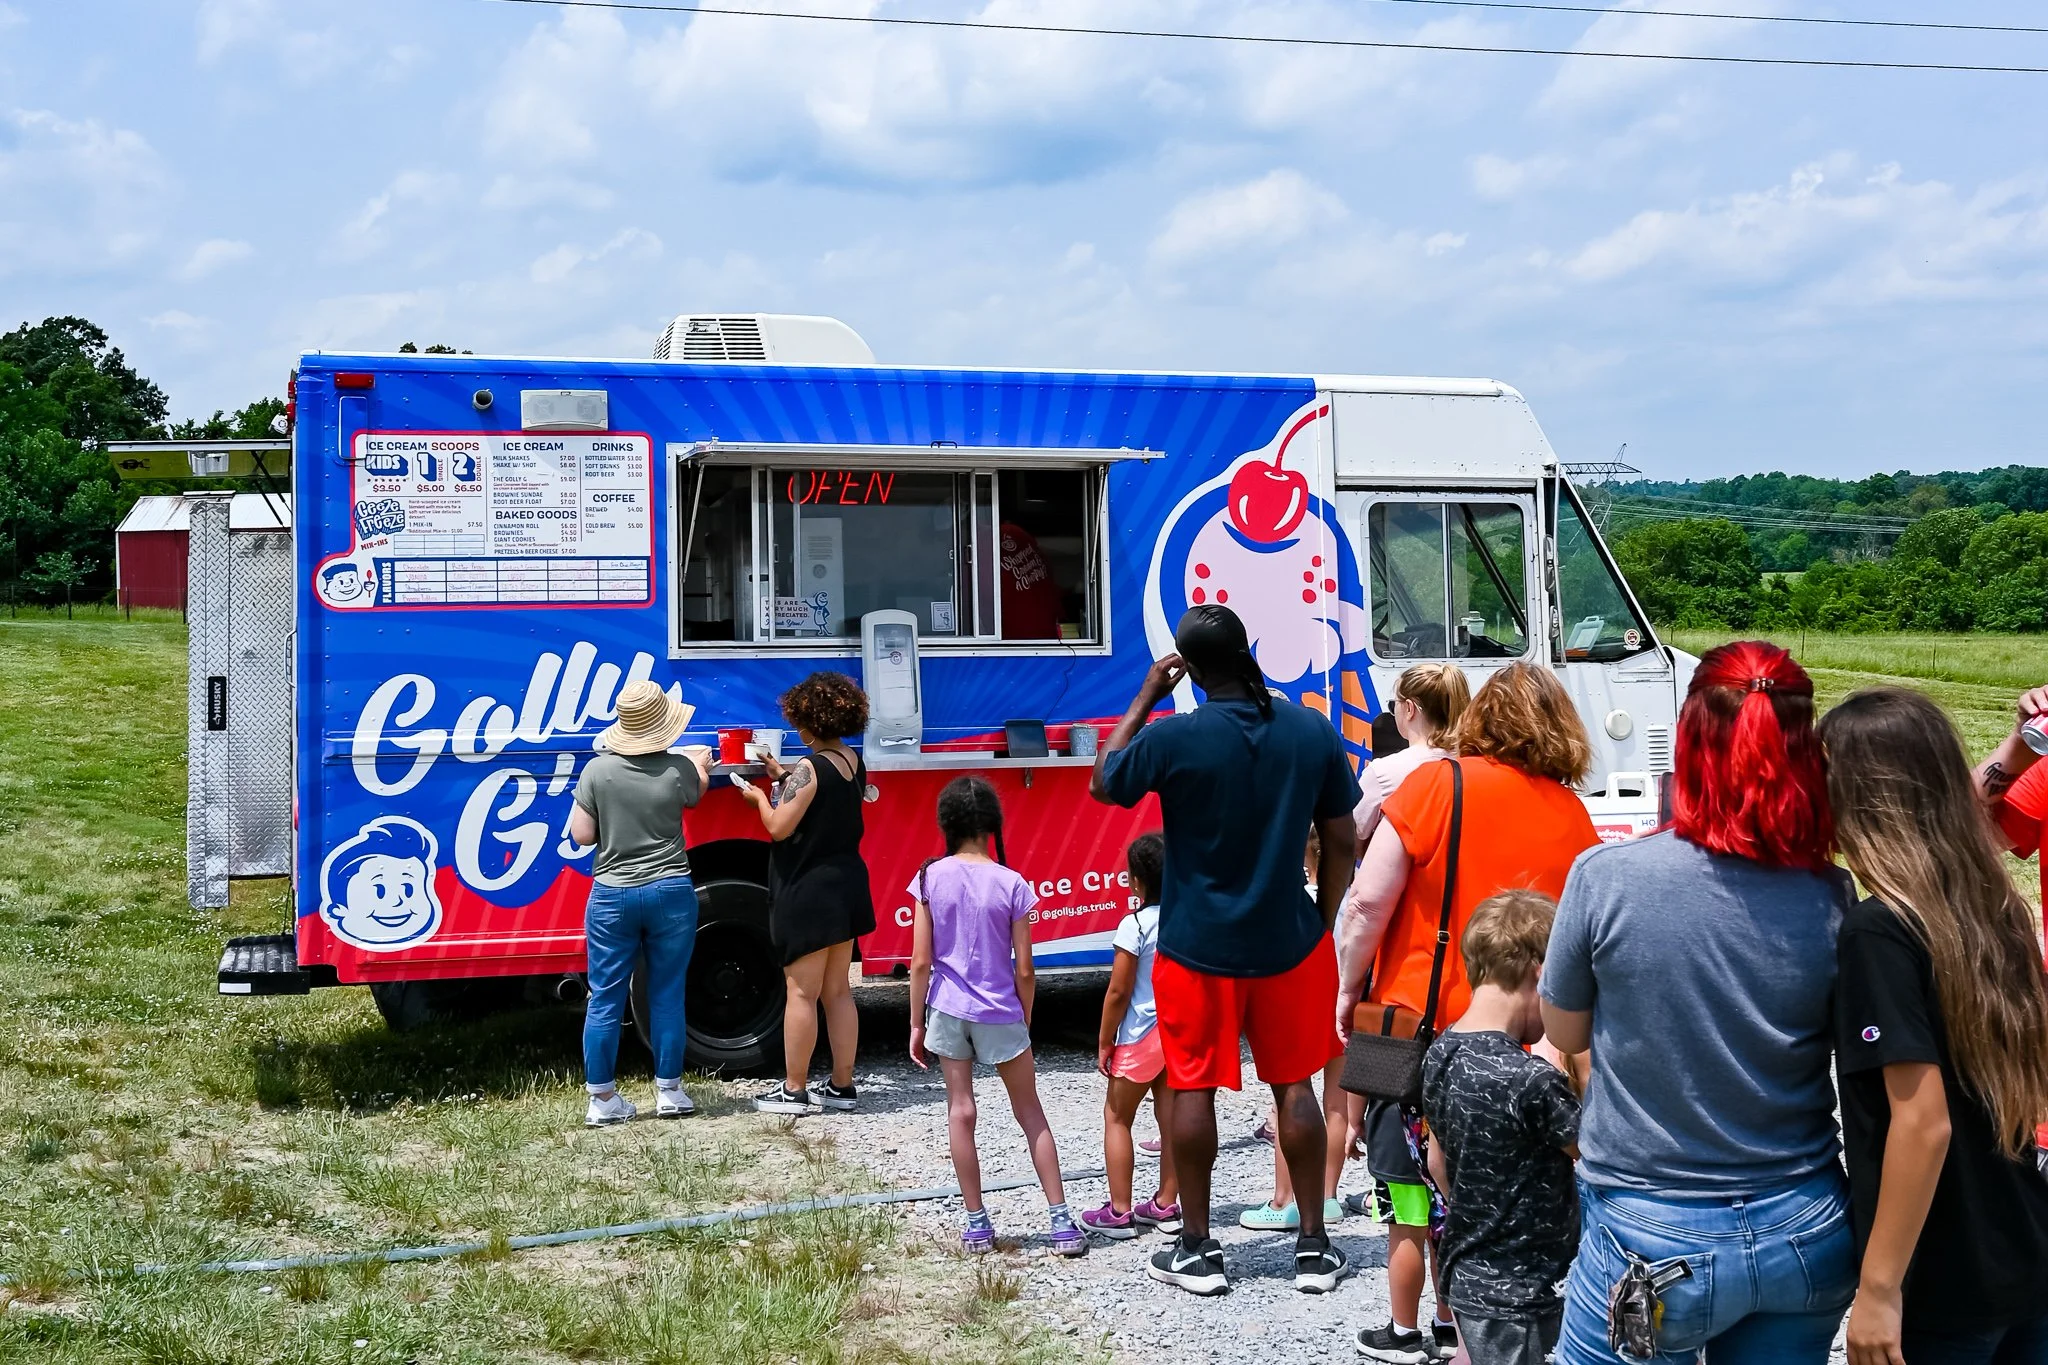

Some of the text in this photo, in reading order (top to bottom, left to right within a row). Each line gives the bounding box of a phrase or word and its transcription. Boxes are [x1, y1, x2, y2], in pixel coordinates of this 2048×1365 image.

[366, 442, 480, 450] ICE CREAM SCOOPS
[592, 443, 633, 451] DRINKS
[365, 454, 402, 470] KIDS
[788, 472, 894, 504] OPEN
[593, 494, 635, 502] COFFEE
[357, 500, 403, 517] Geeze
[496, 511, 577, 519] BAKED GOODS
[359, 513, 404, 534] Freeze
[382, 562, 392, 603] FLAVORS
[1083, 872, 1130, 891] Cre
[1041, 901, 1117, 920] @golly.gs.truck
